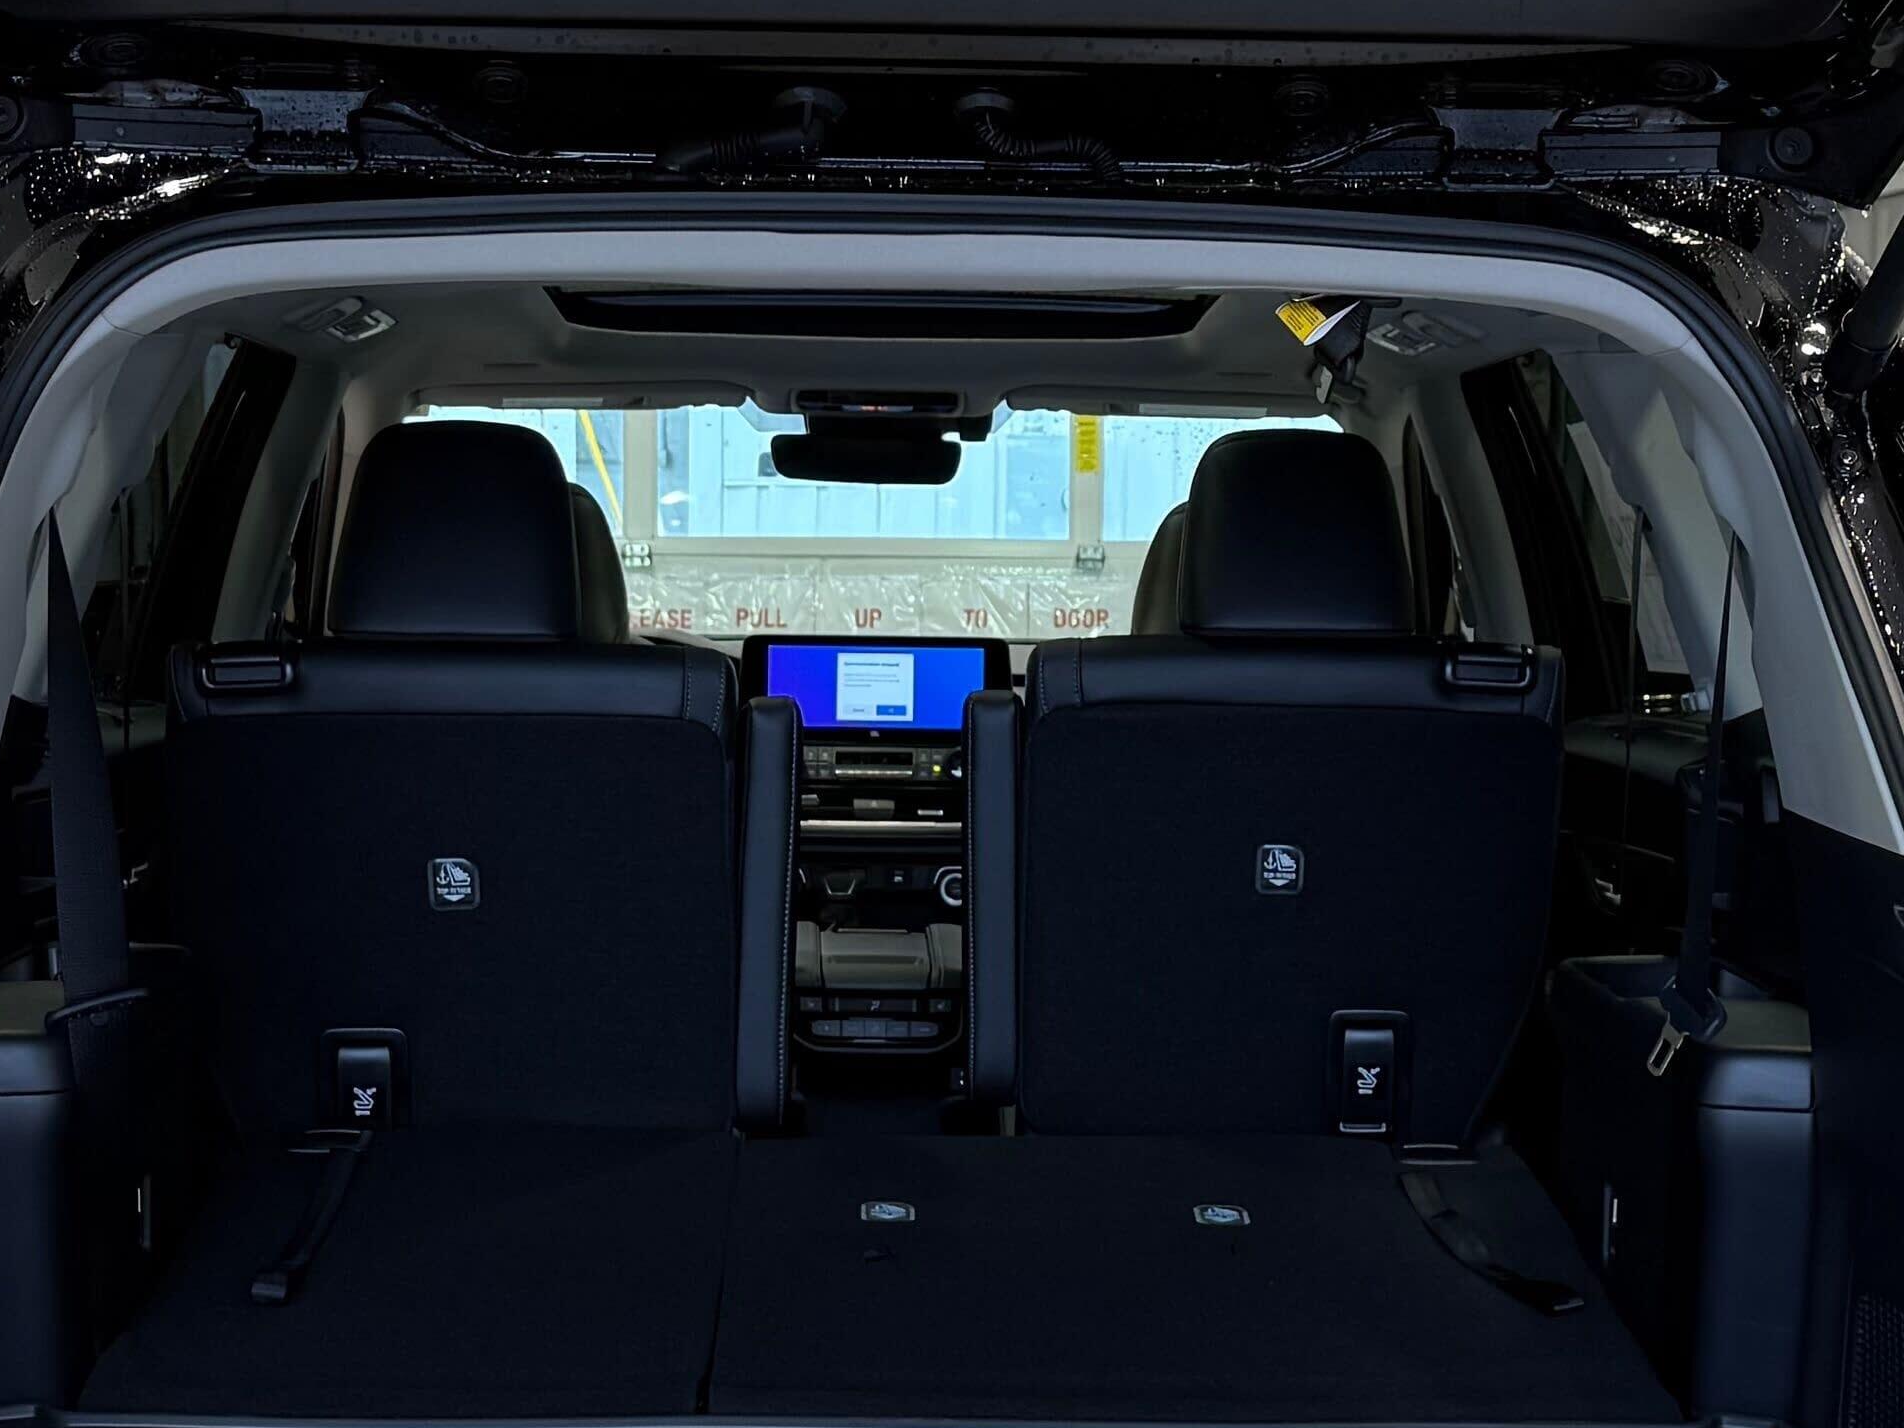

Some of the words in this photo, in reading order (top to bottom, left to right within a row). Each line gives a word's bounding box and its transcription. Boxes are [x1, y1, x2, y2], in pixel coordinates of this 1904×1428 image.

[629, 608, 693, 629] EASE
[736, 608, 788, 629] PULL
[855, 608, 882, 629] UP
[963, 608, 989, 629] TO
[1053, 608, 1110, 629] DOOR
